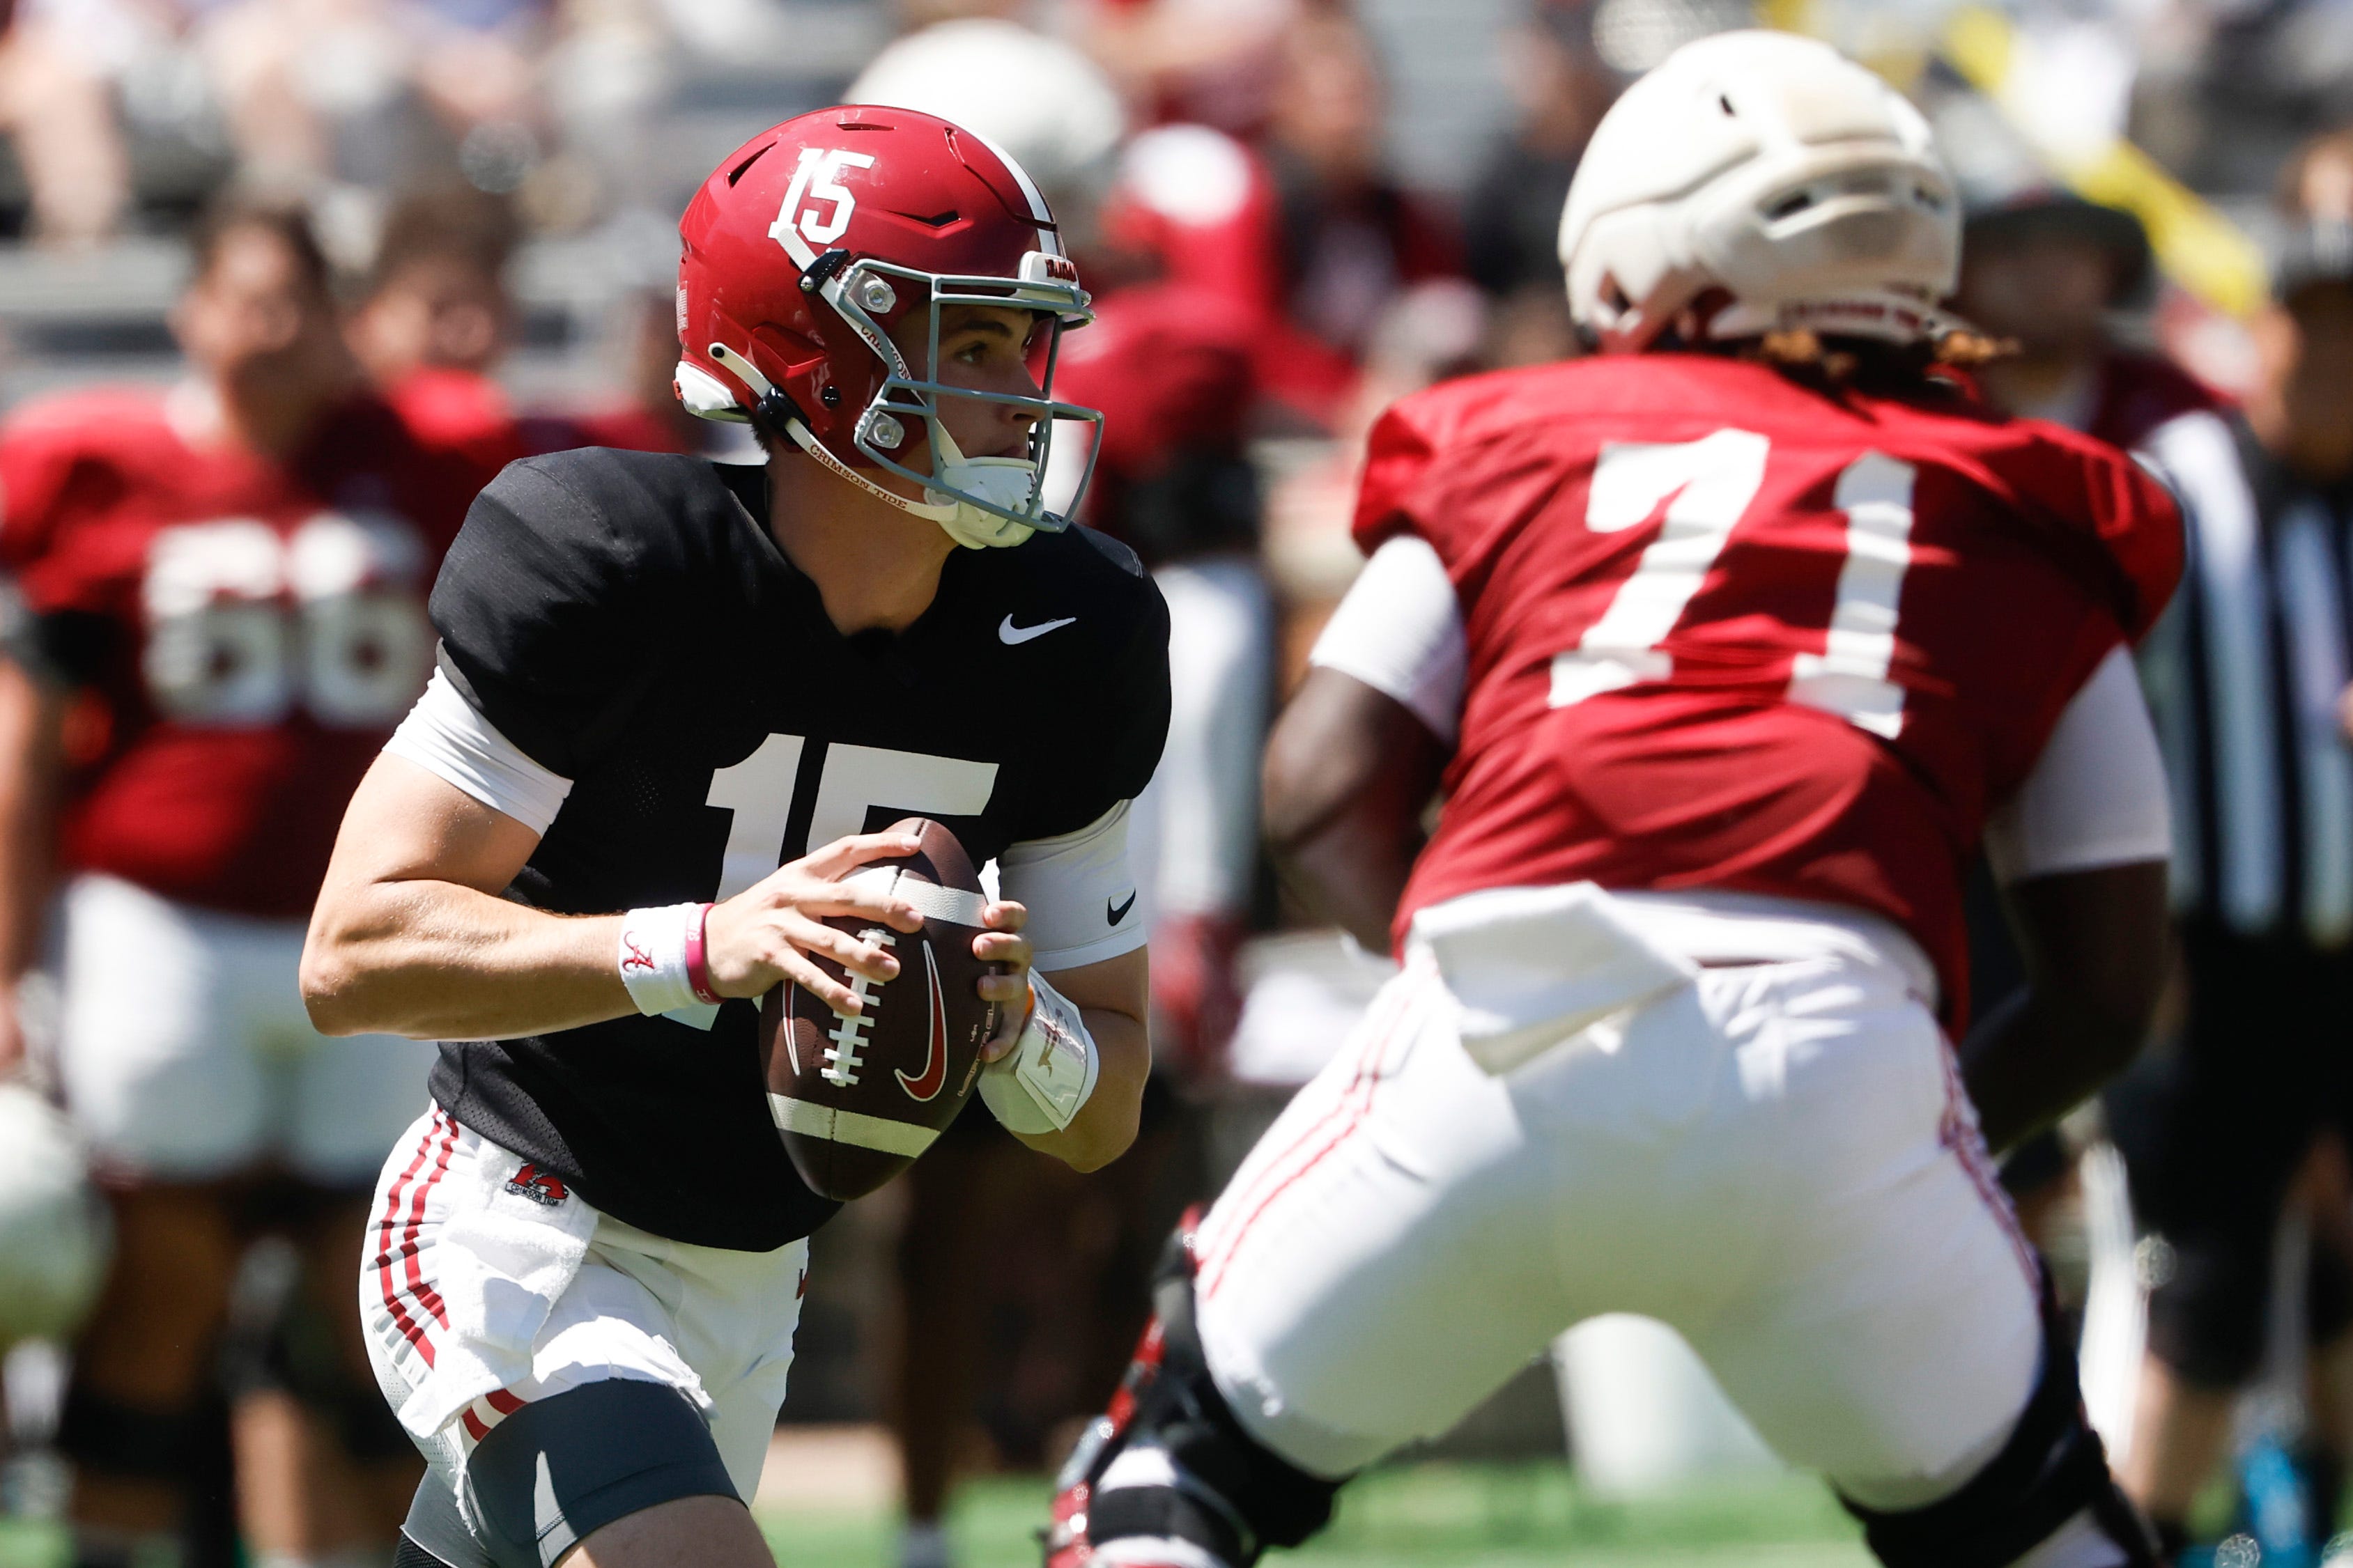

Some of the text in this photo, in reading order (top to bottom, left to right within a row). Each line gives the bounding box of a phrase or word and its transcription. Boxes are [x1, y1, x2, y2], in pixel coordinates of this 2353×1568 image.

[767, 148, 876, 244] 15
[810, 444, 907, 509] CRIMSON TIDE
[1548, 427, 1918, 740] 71
